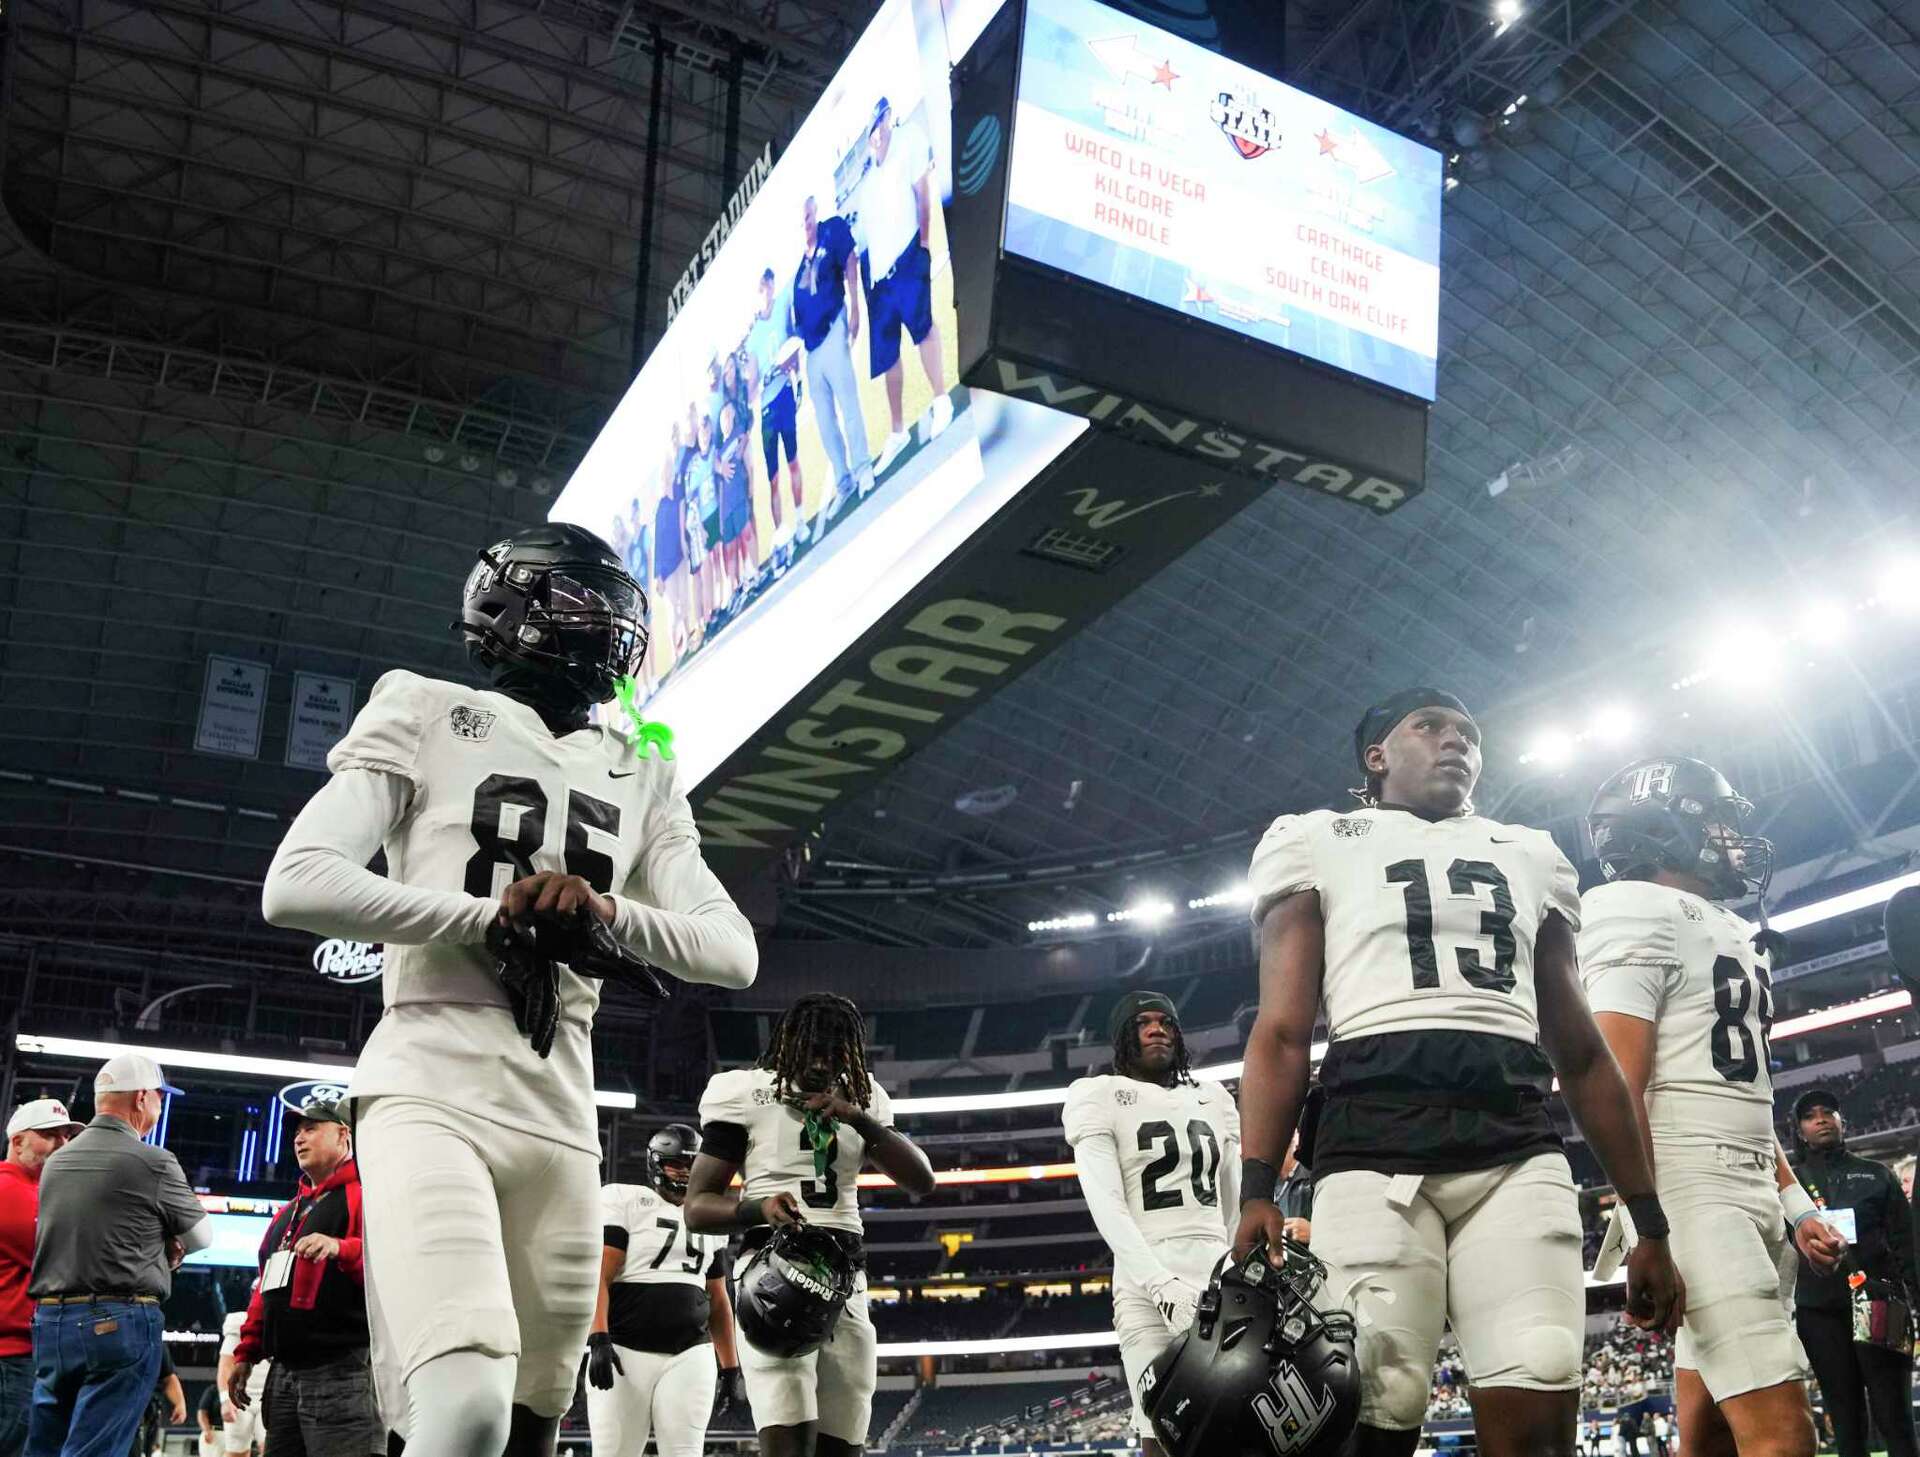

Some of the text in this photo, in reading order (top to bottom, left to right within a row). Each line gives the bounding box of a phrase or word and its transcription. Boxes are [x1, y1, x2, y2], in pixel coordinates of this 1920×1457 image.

[1064, 132, 1206, 202] WACO LA VEGA
[1095, 175, 1174, 218] KILGORE
[701, 141, 773, 273] STADIUM
[1296, 224, 1384, 272] CARTHAGE
[1310, 257, 1369, 293] CELINA
[1265, 267, 1408, 333] SOUTH OAK CLIFF
[996, 359, 1409, 510] WINSTAR
[696, 597, 1067, 850] WINSTAR
[1385, 858, 1517, 995] 13
[1136, 1118, 1221, 1212] 20
[786, 1266, 834, 1302] Riddell
